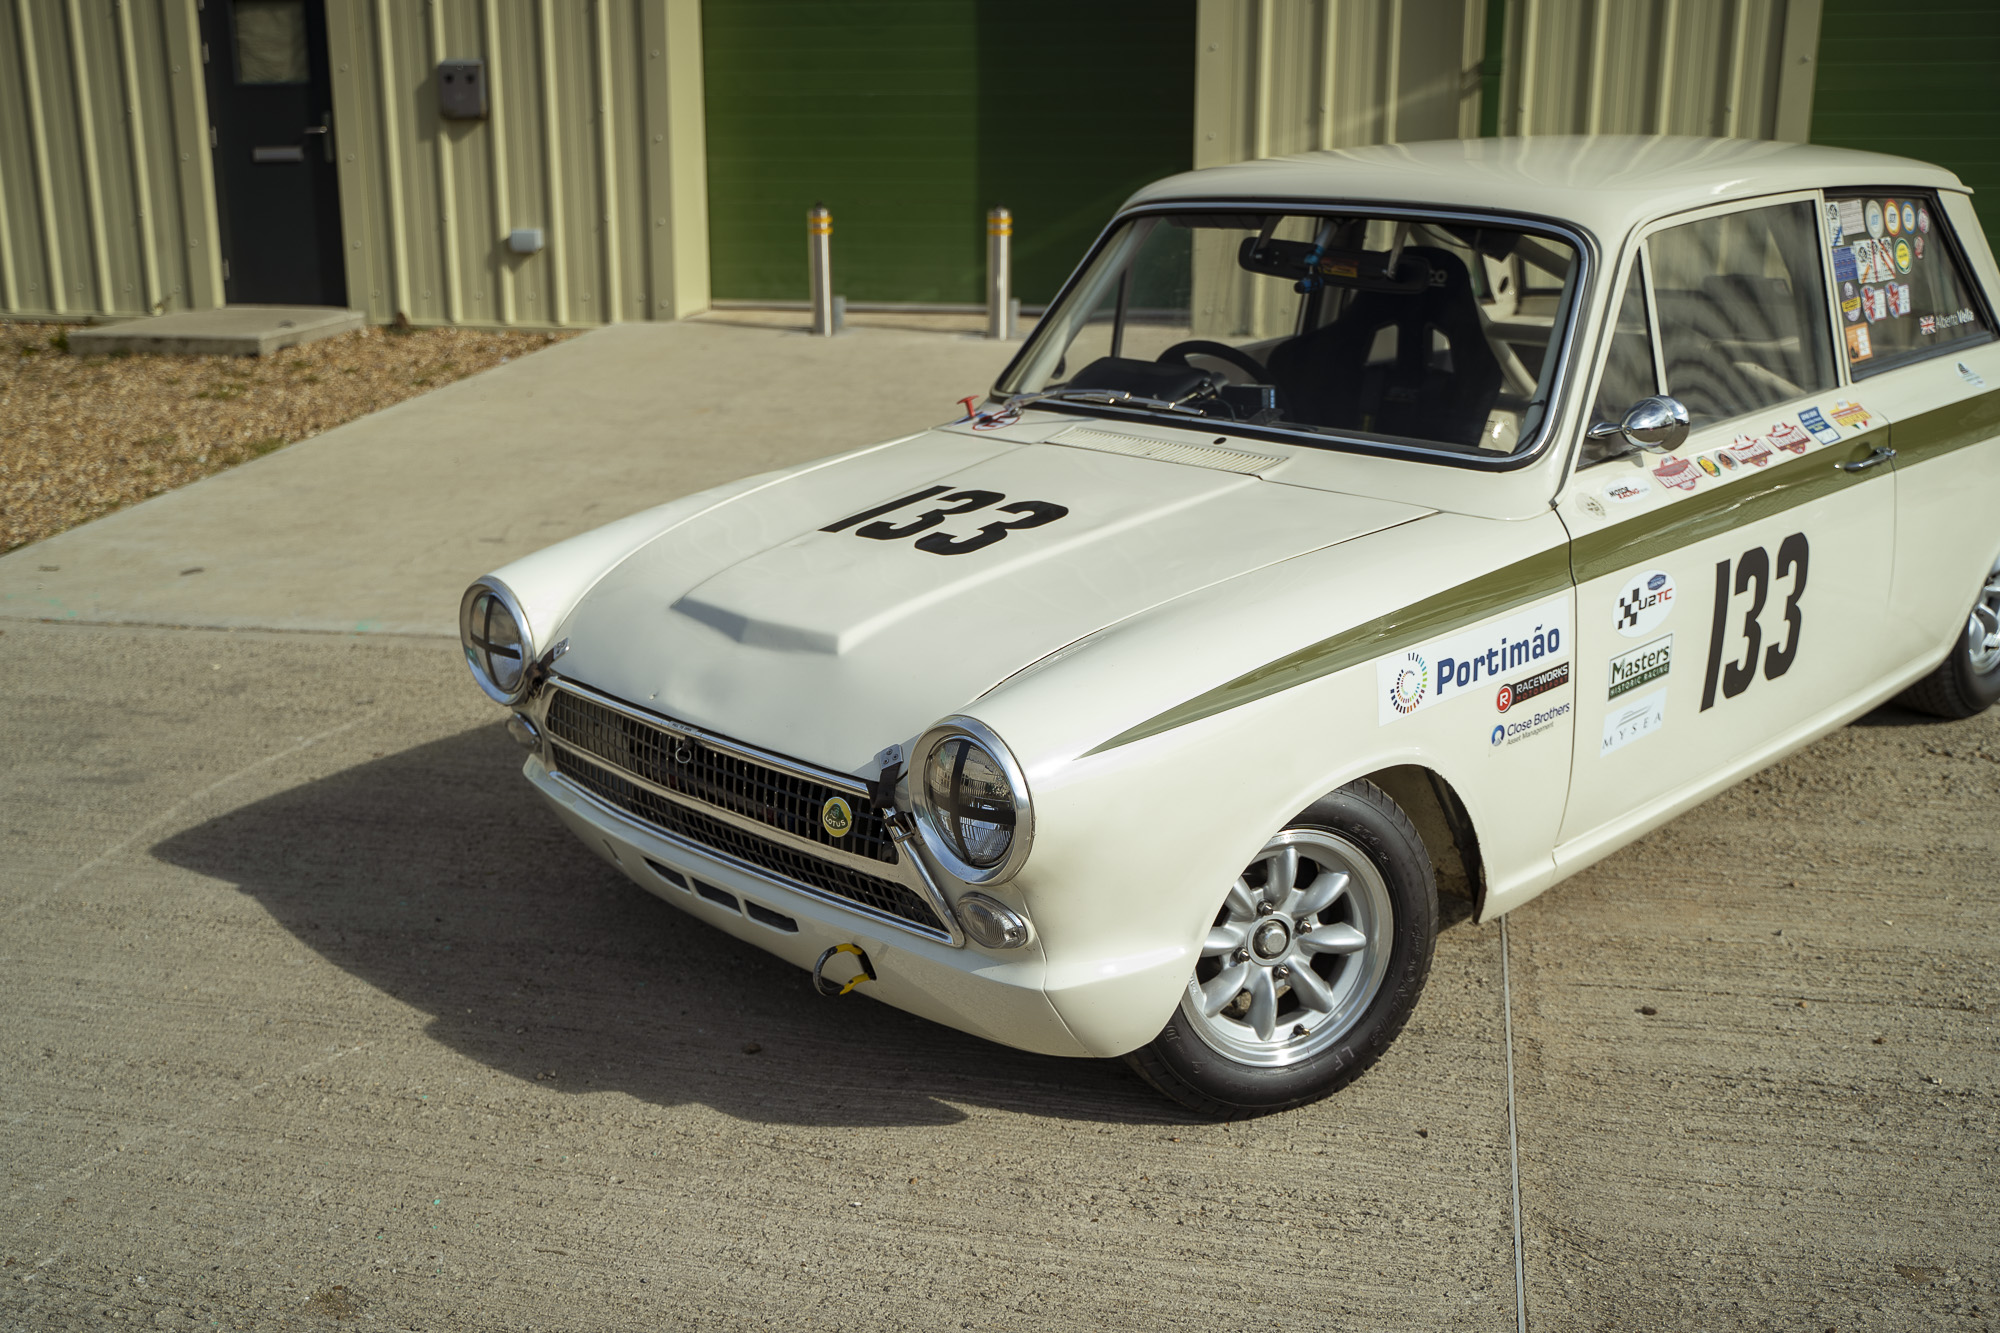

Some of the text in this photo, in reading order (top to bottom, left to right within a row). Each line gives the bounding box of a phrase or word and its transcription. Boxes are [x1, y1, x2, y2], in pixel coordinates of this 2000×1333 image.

[817, 485, 1069, 556] 133
[1638, 588, 1672, 610] U2TC
[1699, 532, 1809, 713] 133
[1437, 624, 1560, 695] Portimão
[1611, 645, 1670, 684] Masters
[1516, 664, 1568, 694] RACEWORKS
[1516, 676, 1568, 701] MOTORSPORT
[1610, 663, 1669, 696] HISTORIC RACING
[1500, 692, 1508, 706] R
[1507, 702, 1570, 736] Close Brothers
[1507, 721, 1554, 745] Asset Management
[825, 815, 846, 827] LOTUS
